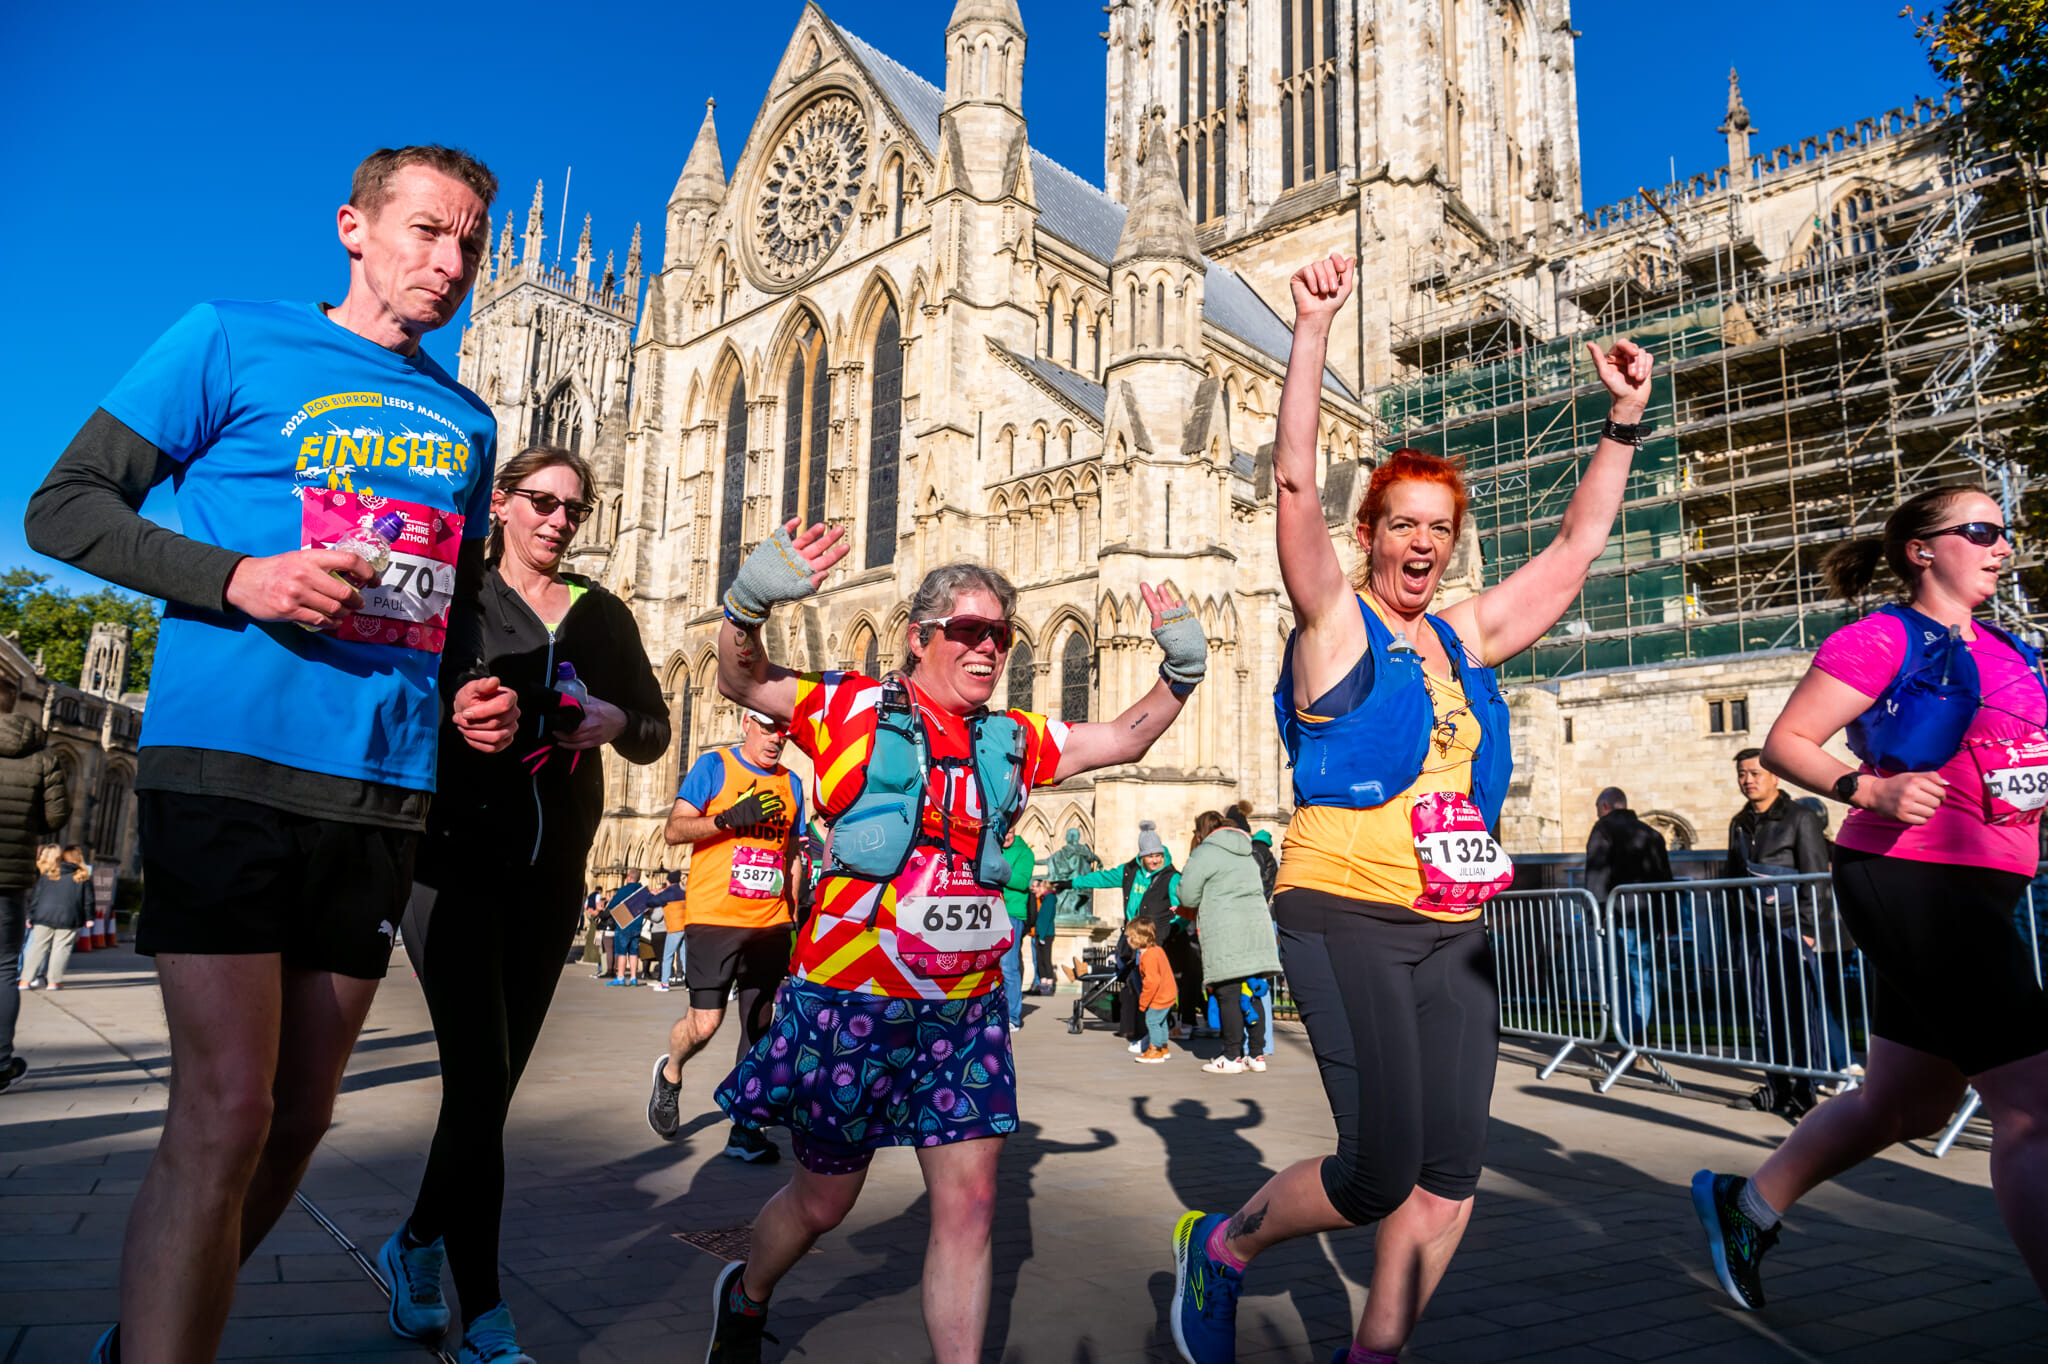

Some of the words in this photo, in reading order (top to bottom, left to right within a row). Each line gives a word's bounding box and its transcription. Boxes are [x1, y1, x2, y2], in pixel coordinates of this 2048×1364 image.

[281, 410, 308, 438] 2023
[307, 400, 331, 414] ROB
[331, 393, 381, 406] BURROW
[384, 396, 415, 411] LEEDS
[417, 406, 471, 448] MARATHON
[295, 435, 470, 472] FINISHER
[399, 532, 429, 545] ATHON
[373, 596, 406, 613] PAUL
[735, 824, 785, 844] DUDE
[1439, 837, 1497, 863] 1325
[952, 878, 974, 886] MARAT
[1459, 867, 1486, 877] JILLIAN
[922, 903, 992, 932] 6529
